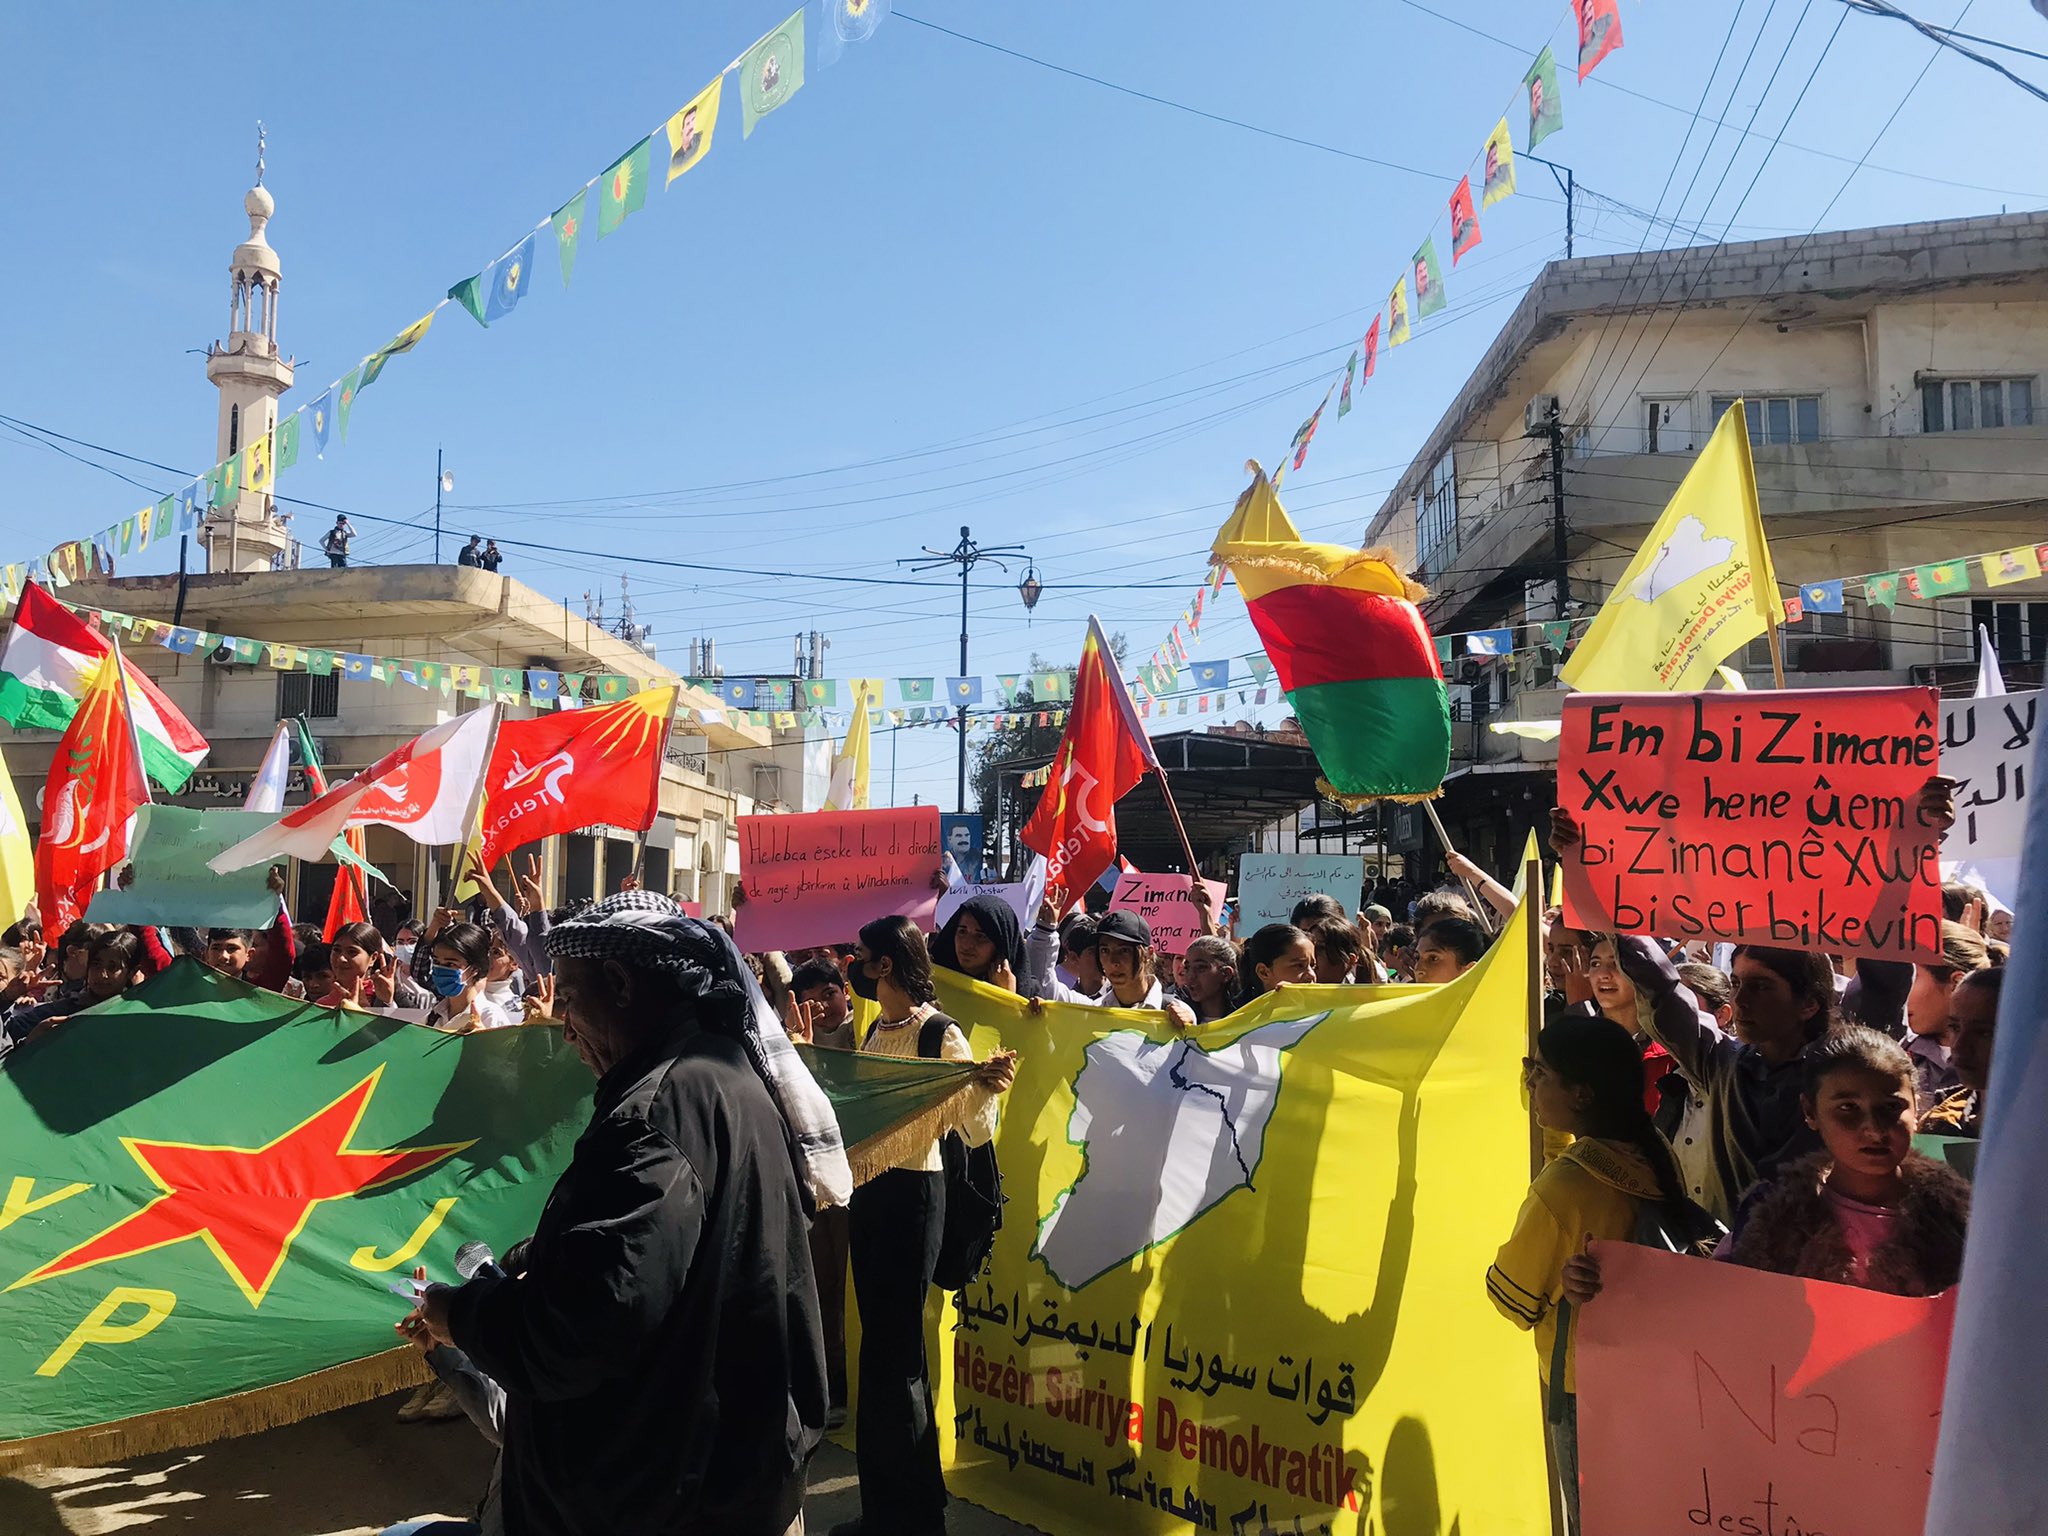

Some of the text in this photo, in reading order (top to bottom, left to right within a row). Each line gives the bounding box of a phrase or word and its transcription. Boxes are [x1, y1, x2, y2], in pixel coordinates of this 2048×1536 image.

[1586, 703, 1664, 756] Em
[1686, 696, 1742, 764] bi
[1578, 768, 1681, 820] Xwe
[1703, 776, 1791, 821] hene
[861, 823, 877, 857] ku
[888, 823, 900, 855] di
[1580, 824, 1616, 867] bi
[749, 876, 763, 898] de
[1119, 880, 1193, 903] Ziman
[1140, 905, 1160, 917] me
[1163, 1323, 1257, 1397] سوريا
[1266, 1353, 1356, 1426] قوات
[954, 1337, 1360, 1513] Hêzên Sûriya Demokratîk
